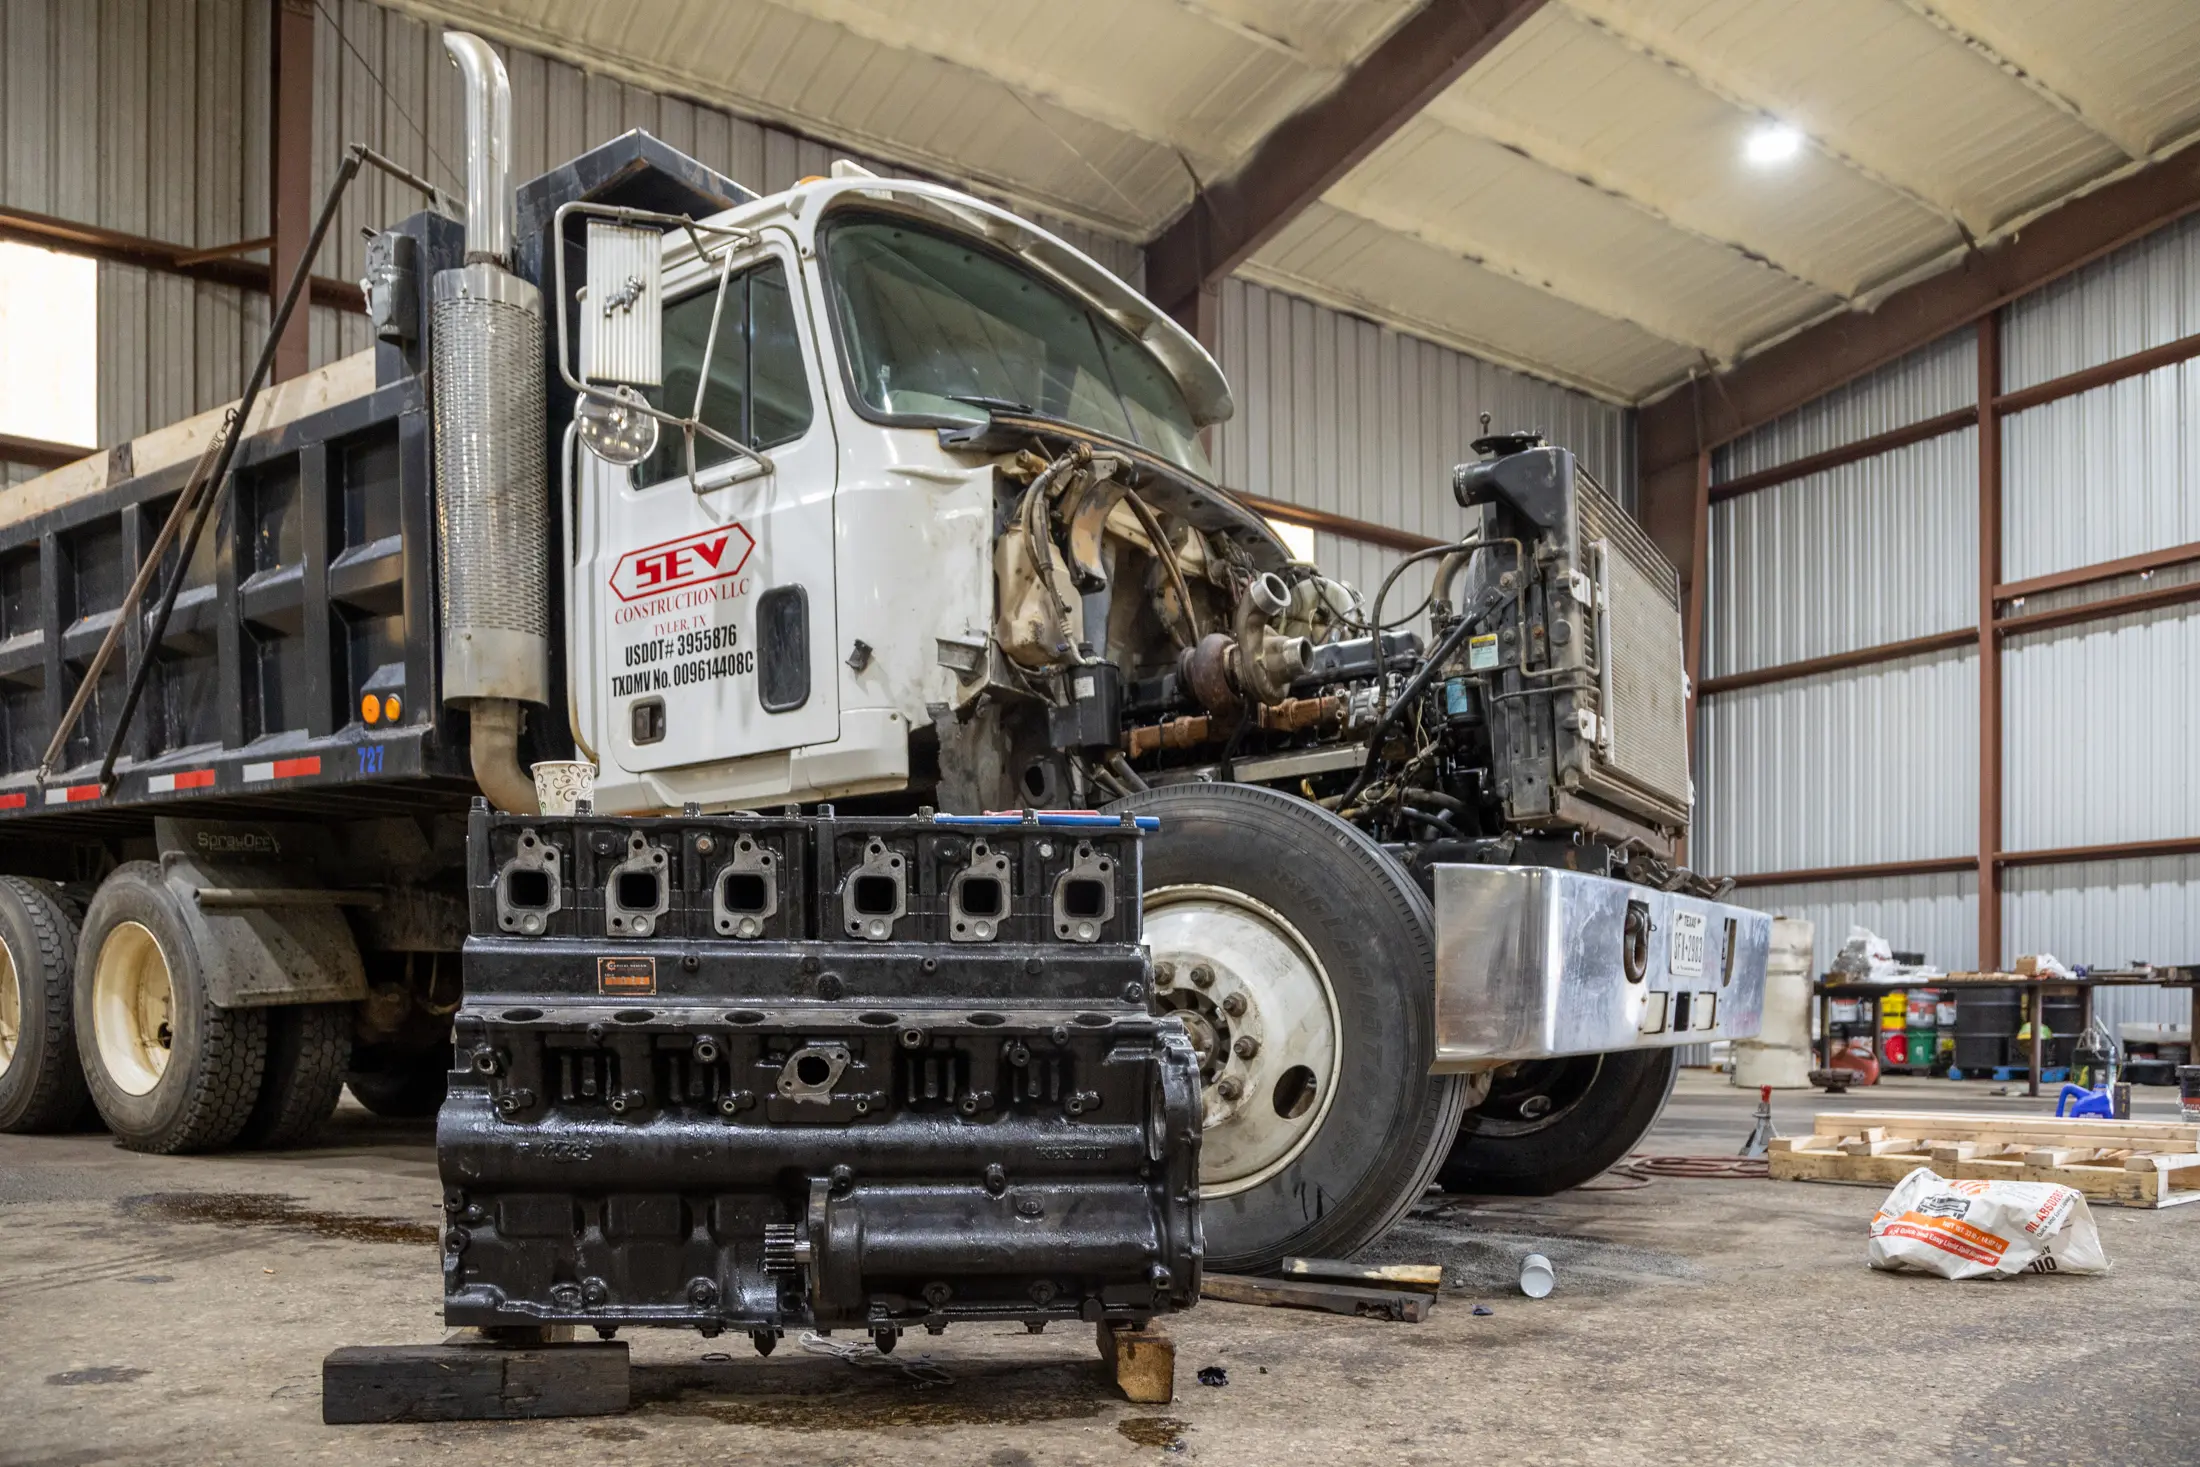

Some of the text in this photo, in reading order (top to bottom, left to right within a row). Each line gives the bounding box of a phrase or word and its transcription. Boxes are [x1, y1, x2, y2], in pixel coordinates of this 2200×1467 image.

[636, 536, 729, 589] SEV
[615, 577, 750, 625] CONSTRUCTION LLC
[655, 614, 706, 637] TYLER, TX
[625, 623, 737, 667] USDOT# 3955876
[612, 650, 754, 697] TXDMV No. 009614408C
[357, 745, 384, 774] 727
[1942, 1220, 1956, 1229] NET
[2024, 1221, 2040, 1234] OIL
[1900, 1228, 1916, 1236] Quick
[1929, 1233, 1944, 1245] Easy
[1944, 1239, 1959, 1250] Liquid
[1958, 1245, 1971, 1255] Spill
[1970, 1249, 1995, 1263] Removal
[2028, 1256, 2057, 1274] OIL
